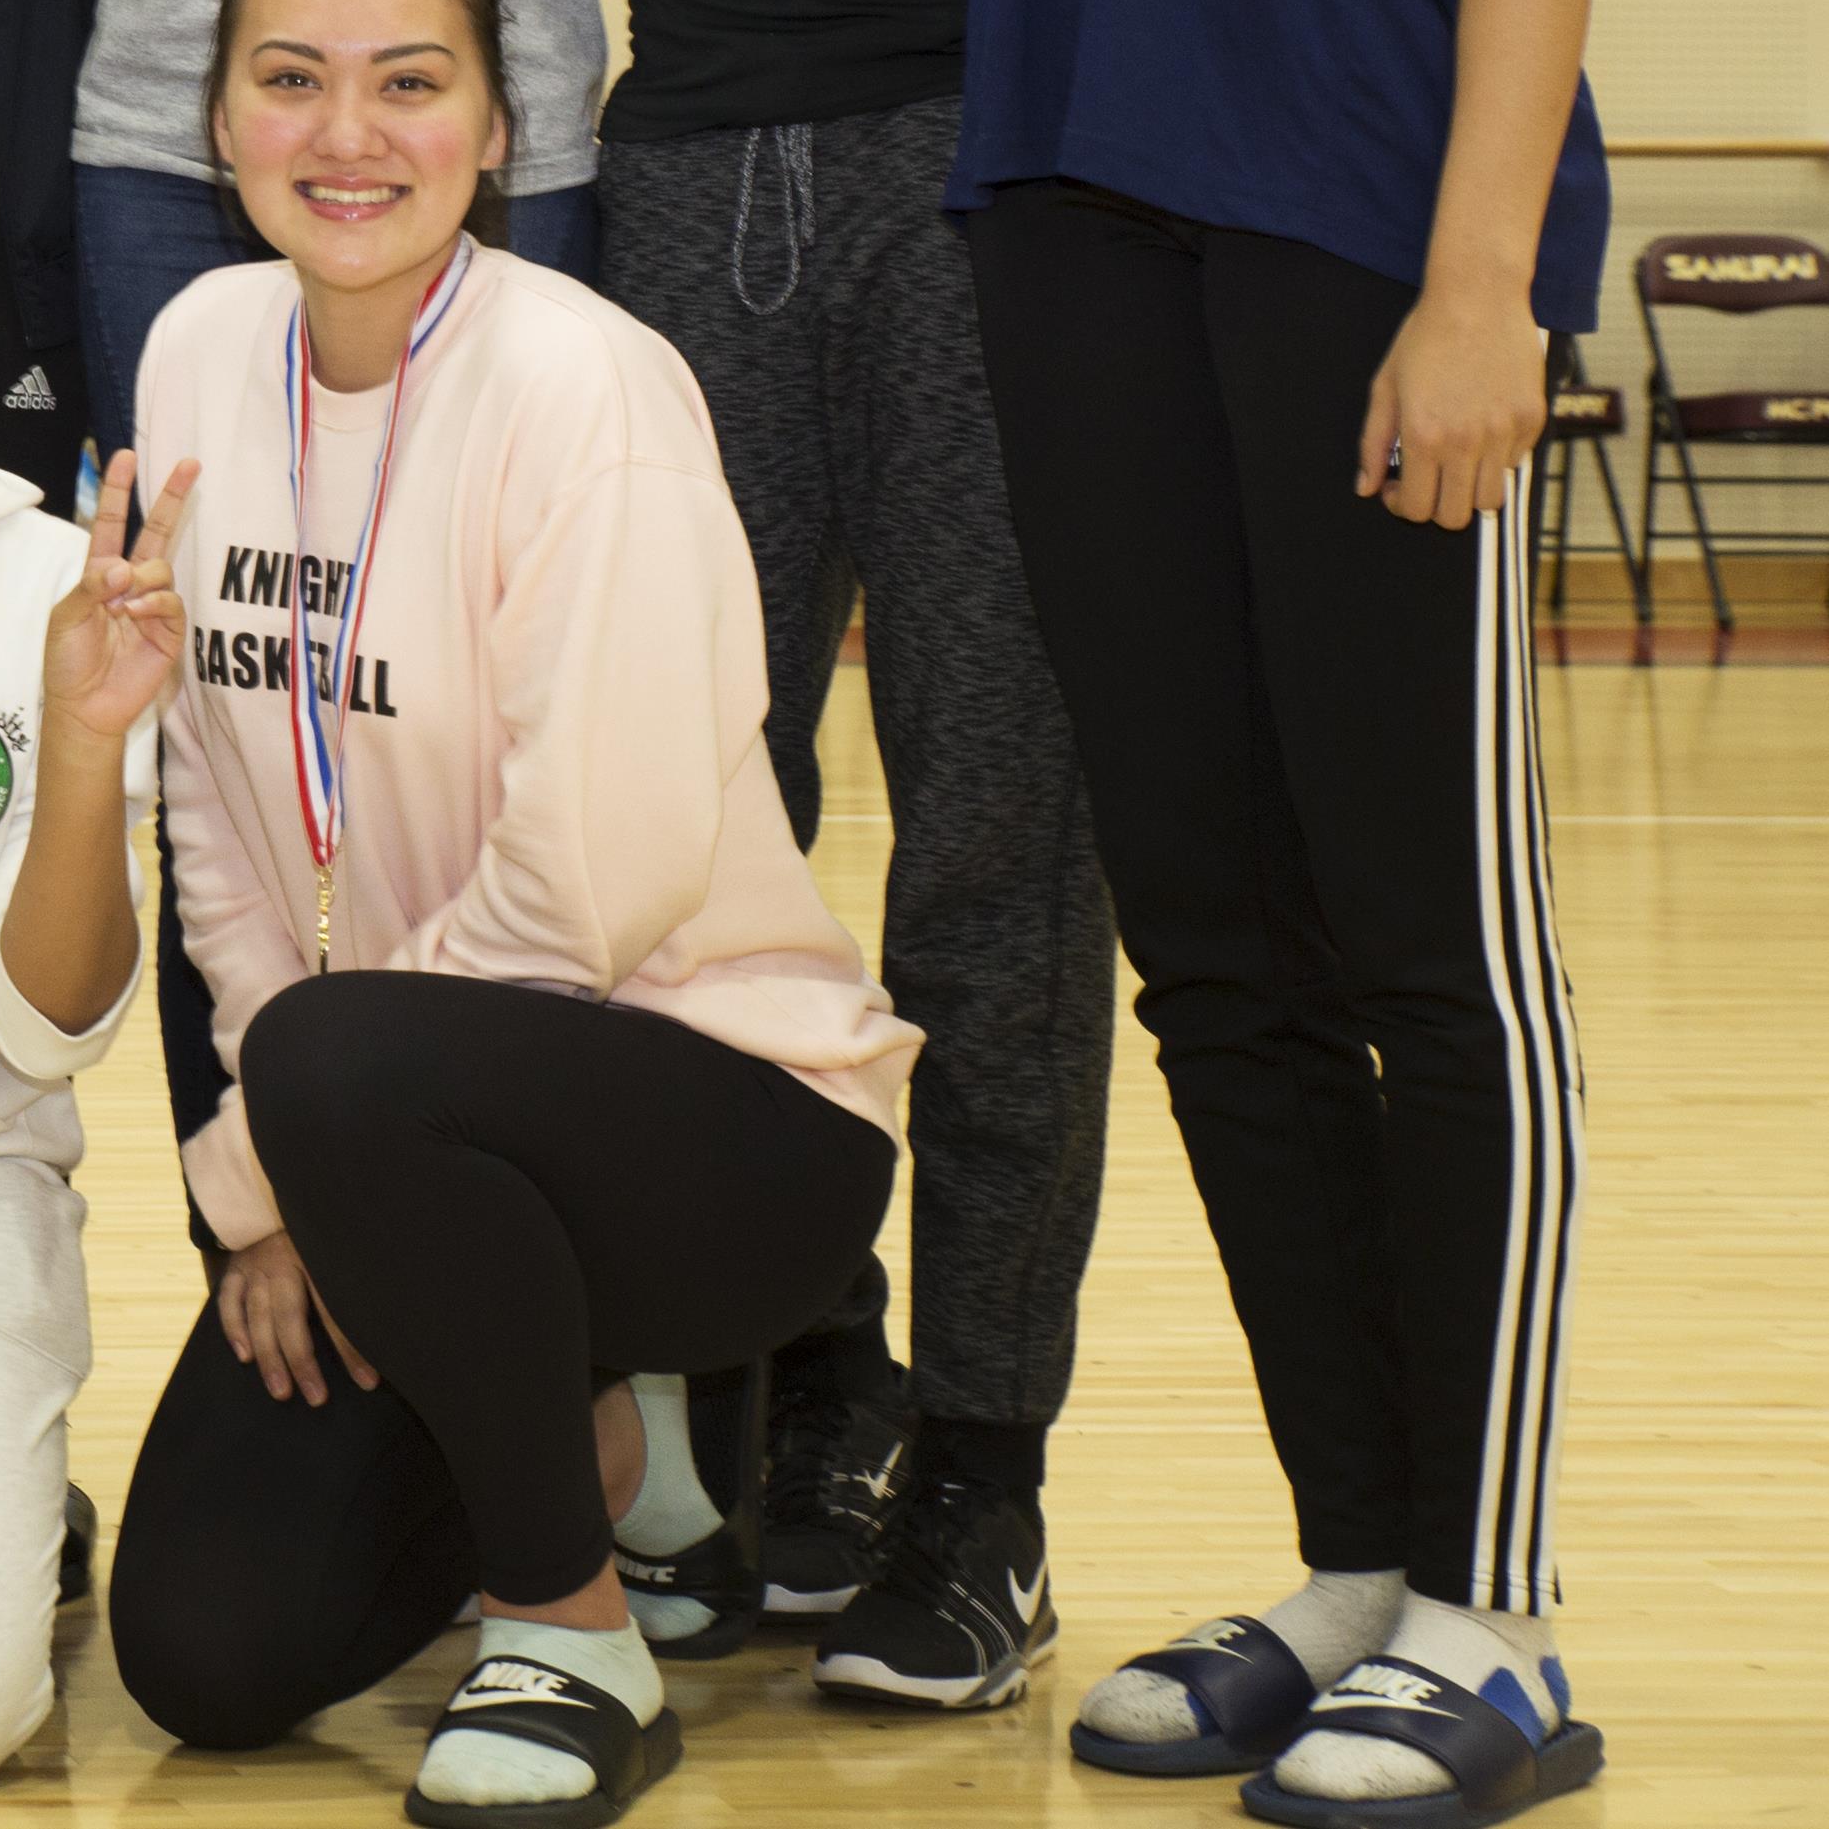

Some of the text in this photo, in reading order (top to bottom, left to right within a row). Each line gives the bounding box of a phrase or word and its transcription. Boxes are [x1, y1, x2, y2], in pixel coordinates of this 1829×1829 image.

[1663, 251, 1819, 284] SAMURAI
[2, 393, 57, 411] adidas
[465, 1660, 570, 1693] NIKE
